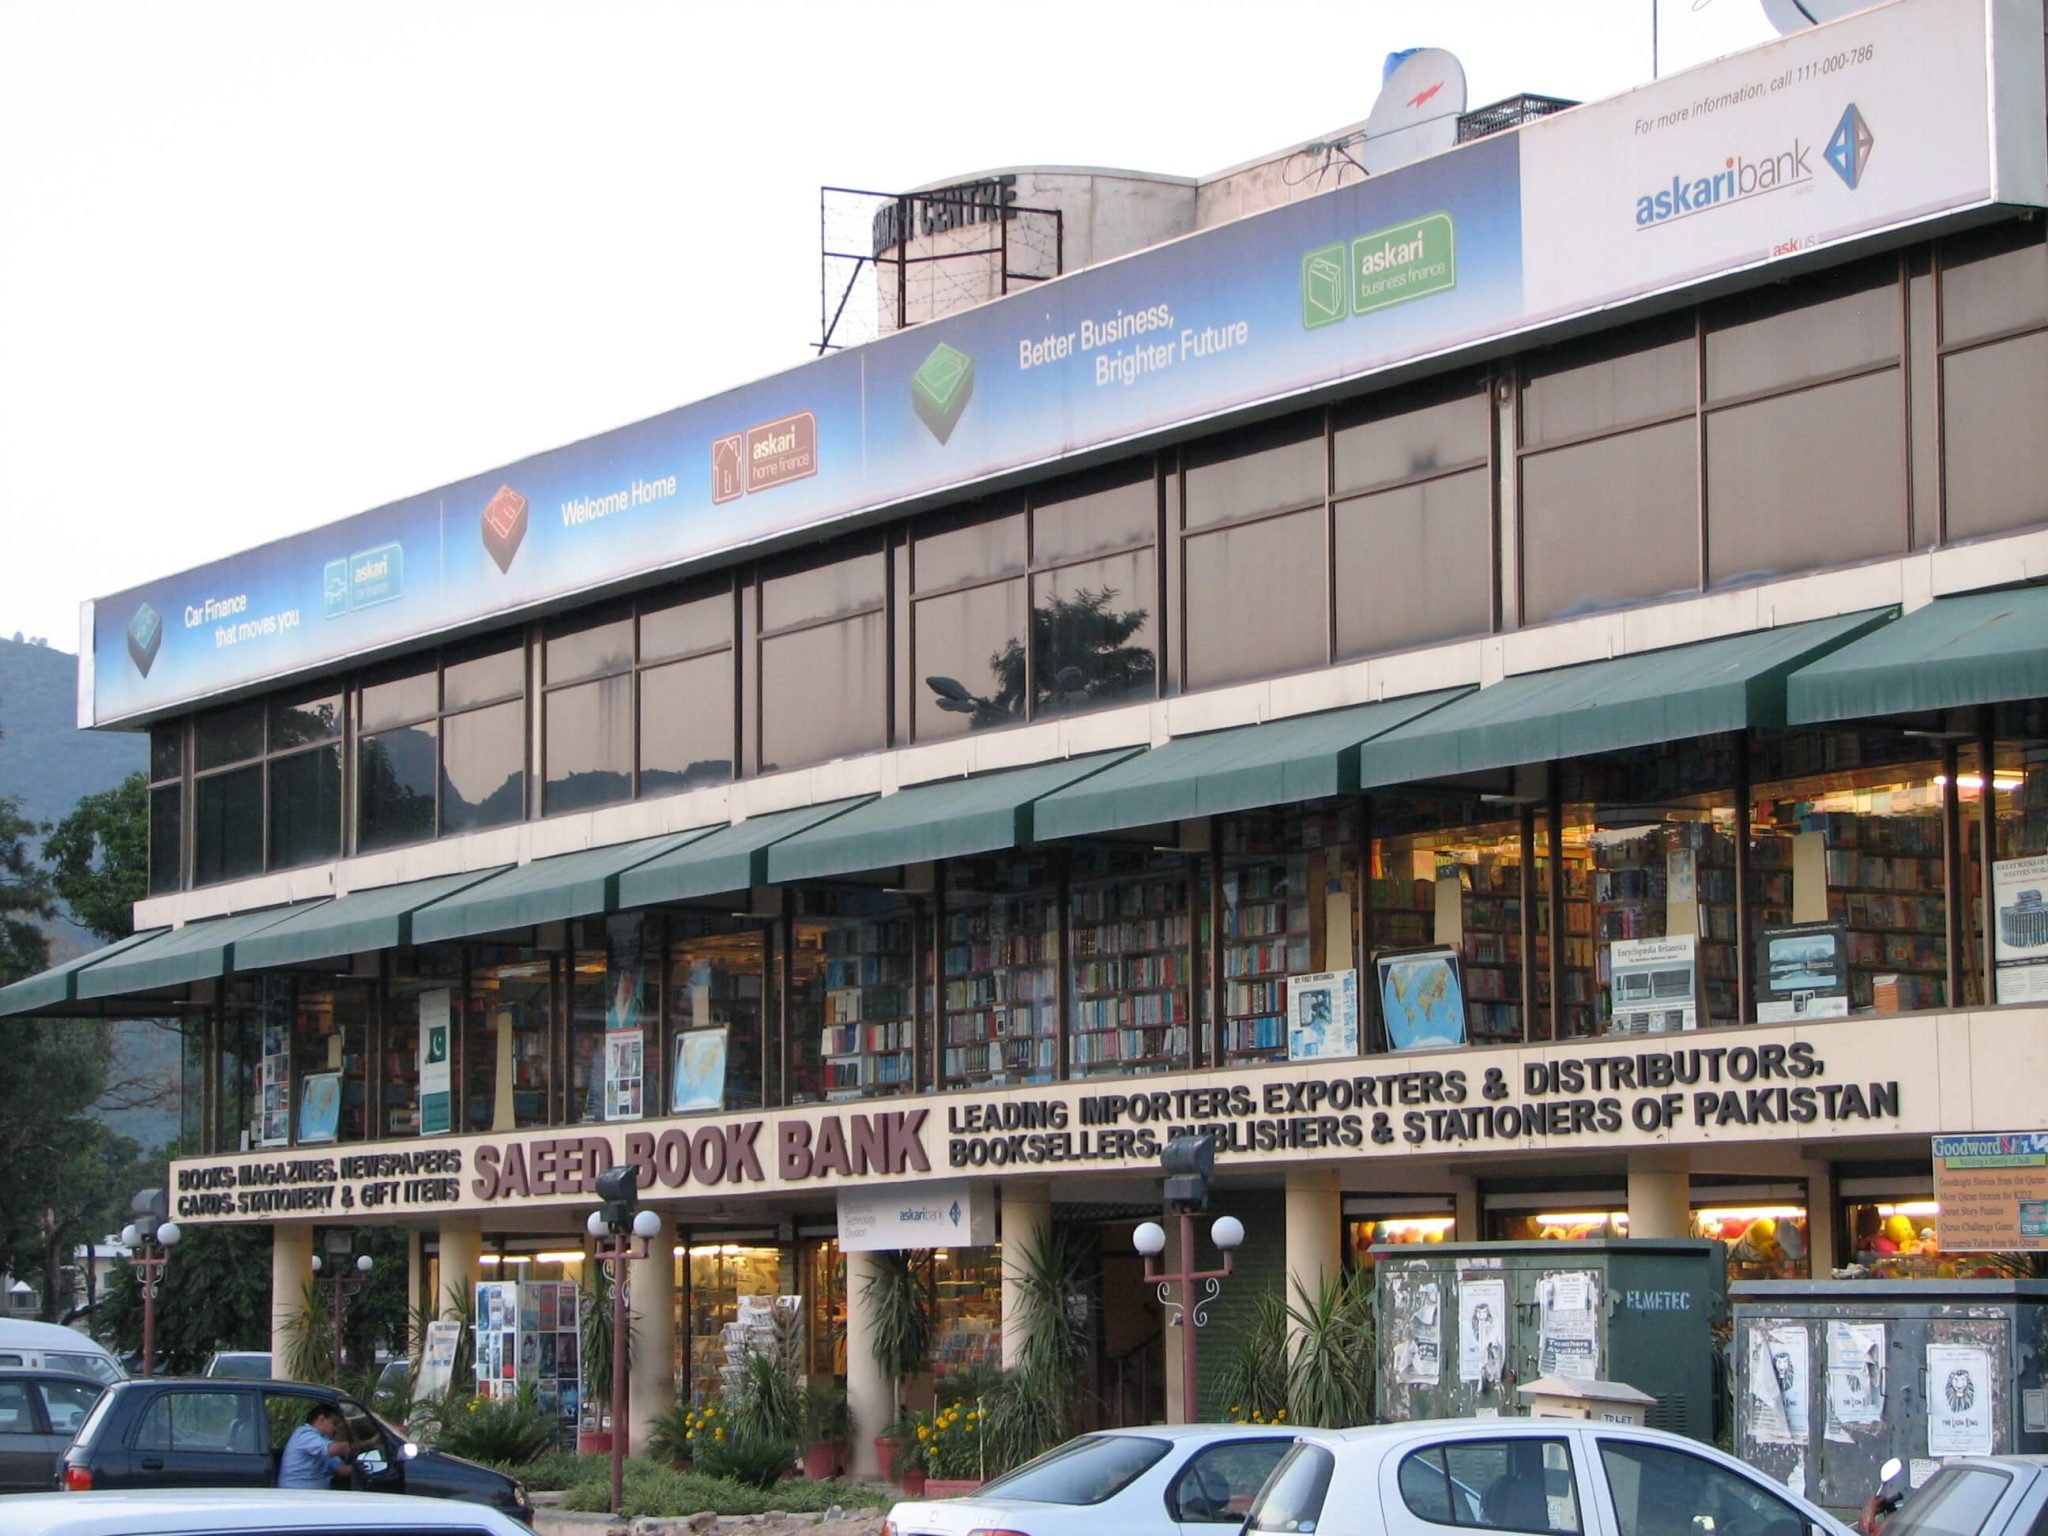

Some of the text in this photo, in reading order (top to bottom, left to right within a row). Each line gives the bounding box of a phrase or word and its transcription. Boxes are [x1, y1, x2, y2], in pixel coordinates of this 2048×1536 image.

[1634, 44, 1874, 136] For more information, call 111-000-786
[920, 174, 1018, 237] CENTRE
[1362, 230, 1423, 276] askari
[1361, 262, 1446, 298] business finance
[1019, 303, 1174, 371] Better Business,
[1095, 320, 1249, 387] Brighter Future
[753, 424, 795, 460] askari
[752, 453, 809, 480] home finance
[561, 474, 677, 528] Welcome Home
[354, 554, 388, 583] askari
[185, 594, 247, 629] Car Finance
[215, 608, 300, 648] that moves you
[947, 1041, 1824, 1136] LEADING IMPORTERS, EXPORTERS & DISTRIBUTORS,
[948, 1128, 1162, 1168] BOOKSELLERS,
[1371, 1111, 1394, 1144] &
[1403, 1097, 1622, 1145] STATIONERS
[1631, 1092, 1683, 1133] OF
[1693, 1080, 1900, 1127] PAKISTAN
[340, 1149, 462, 1180] NEWSPAPERS
[471, 1108, 931, 1200] SAEED BOOK BANK
[1933, 1136, 2001, 1157] Goodword
[238, 1185, 335, 1214] STATIONERY
[340, 1184, 355, 1208] &
[360, 1181, 401, 1208] GIFT
[404, 1178, 460, 1203] ITEMS
[1626, 1290, 1691, 1311] ELMETEC
